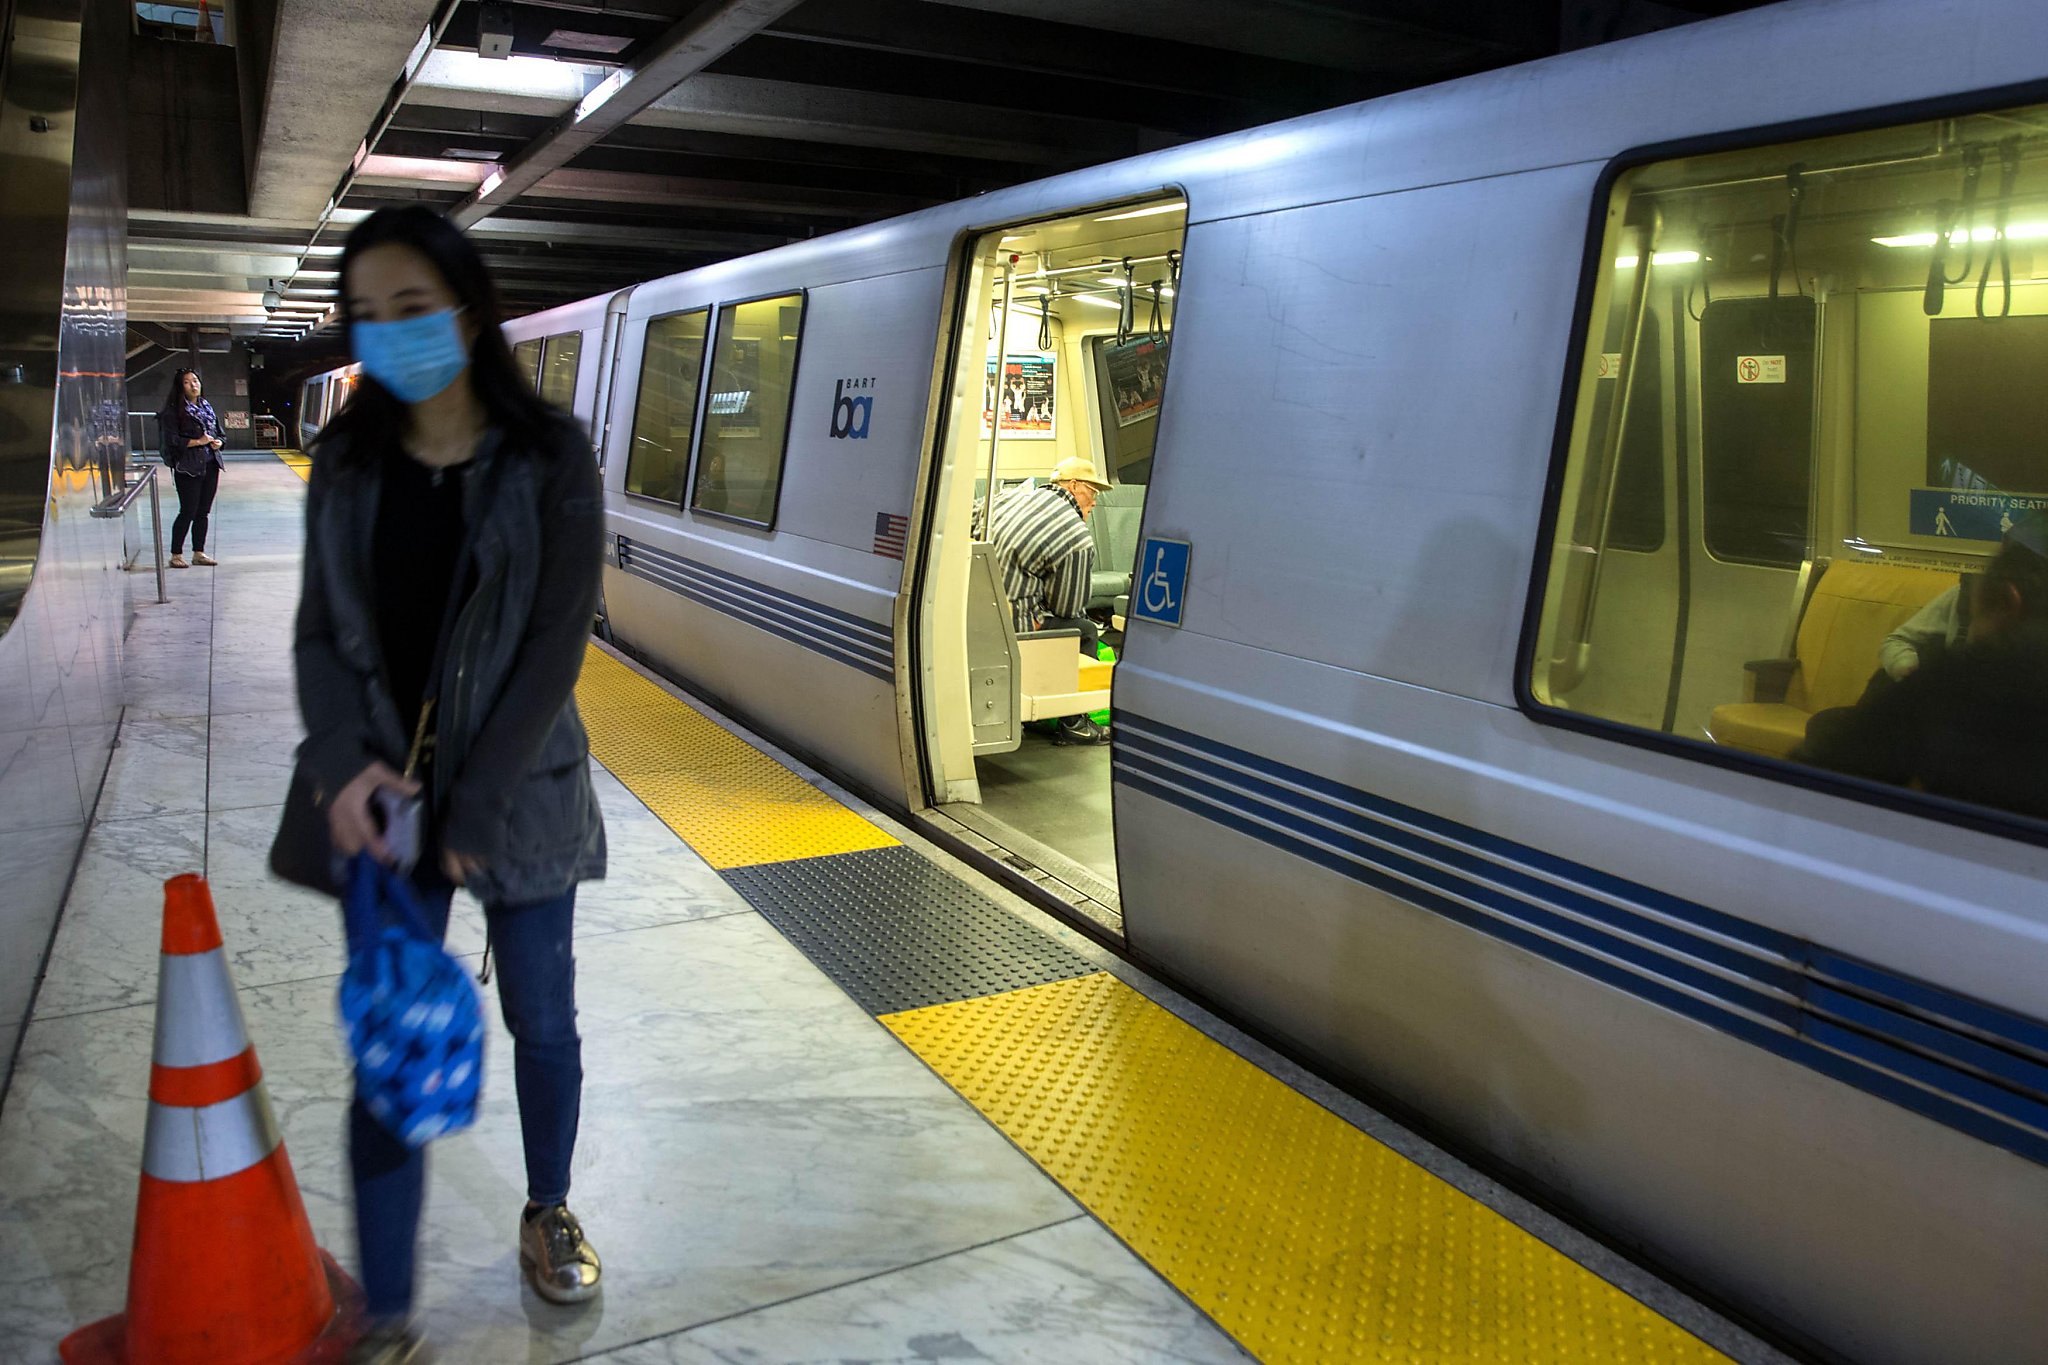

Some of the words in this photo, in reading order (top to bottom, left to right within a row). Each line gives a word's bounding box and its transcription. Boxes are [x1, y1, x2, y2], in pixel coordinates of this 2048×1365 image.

[846, 377, 876, 389] BART
[830, 379, 873, 439] ba
[1950, 494, 2007, 508] PRIORITY
[2009, 498, 2048, 511] SEATI
